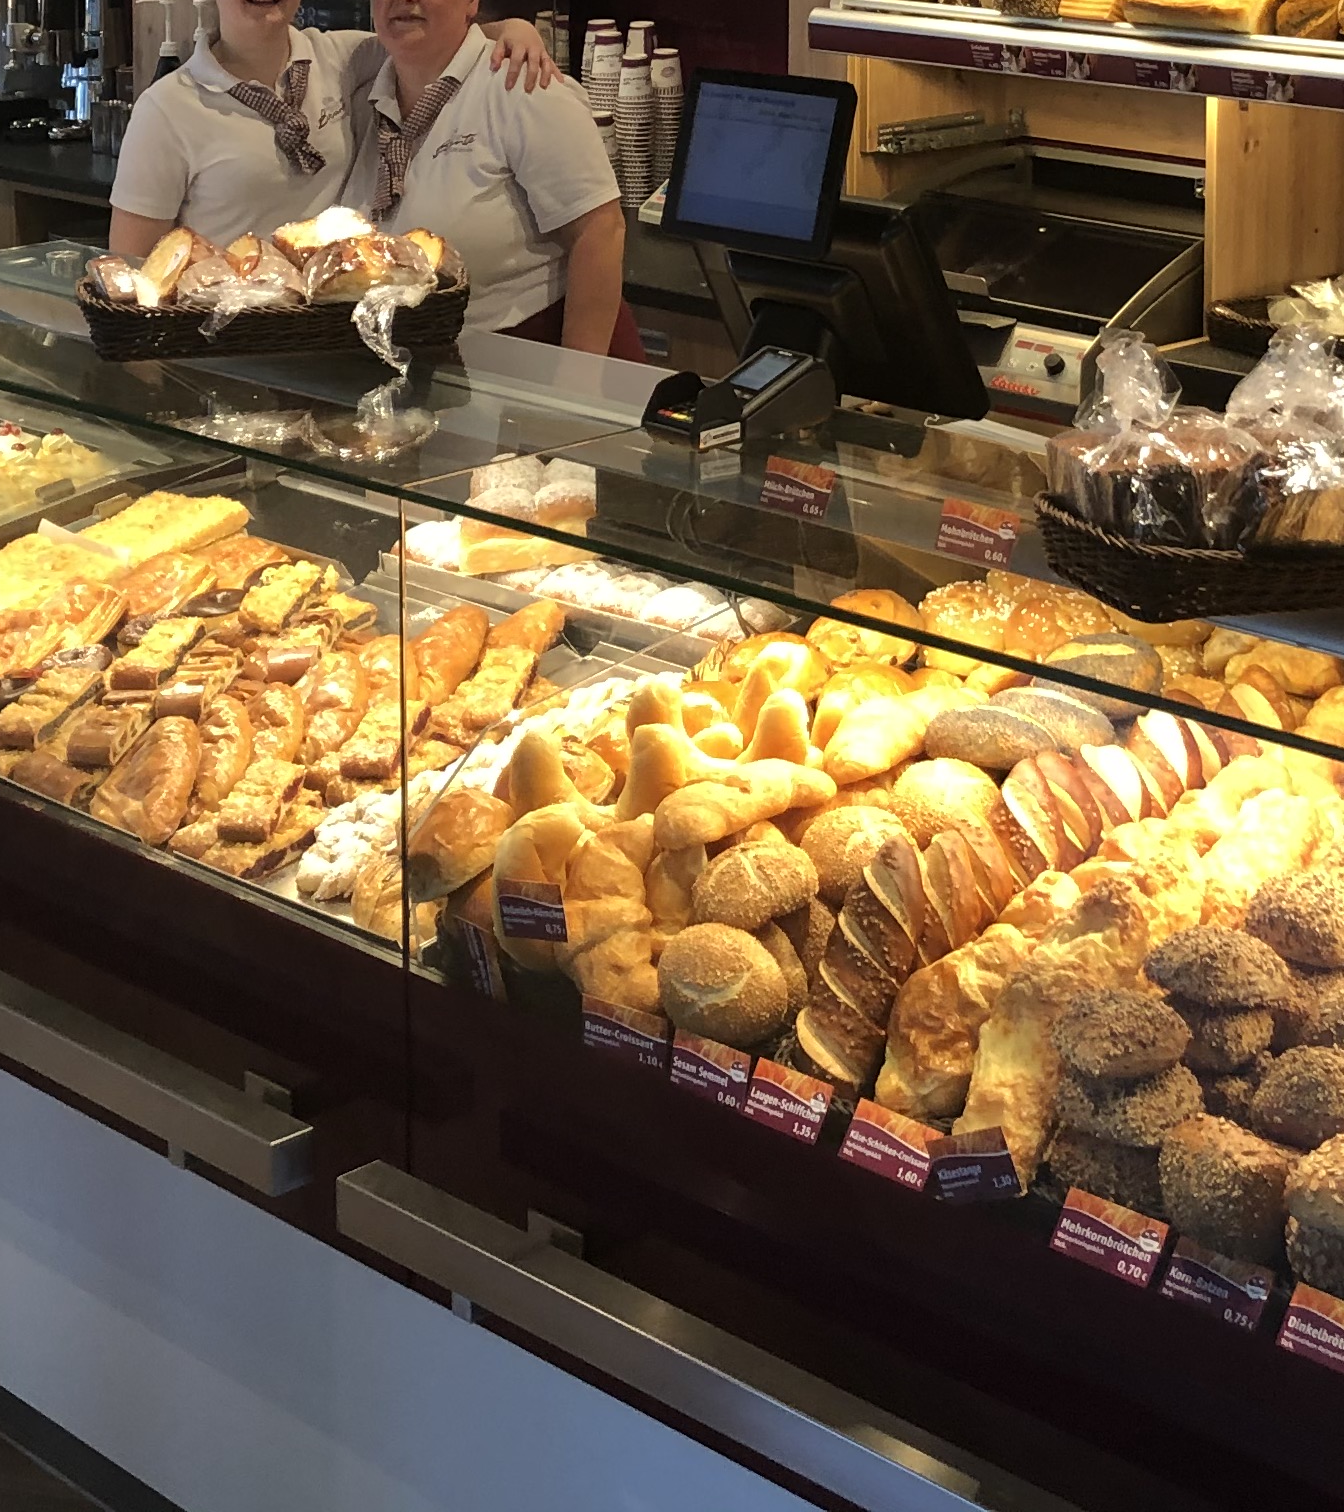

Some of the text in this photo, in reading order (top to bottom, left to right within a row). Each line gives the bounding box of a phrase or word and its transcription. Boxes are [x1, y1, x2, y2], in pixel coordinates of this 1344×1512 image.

[584, 1020, 655, 1051] Butter-Croissant
[672, 1055, 697, 1074] Sesam
[750, 1086, 821, 1124] Laugen-Schiffchen
[849, 1129, 930, 1172] Käse-Schinken-Croissant
[1060, 1217, 1152, 1263] Mehrkornbrötchen
[1116, 1259, 1142, 1279] 0,70
